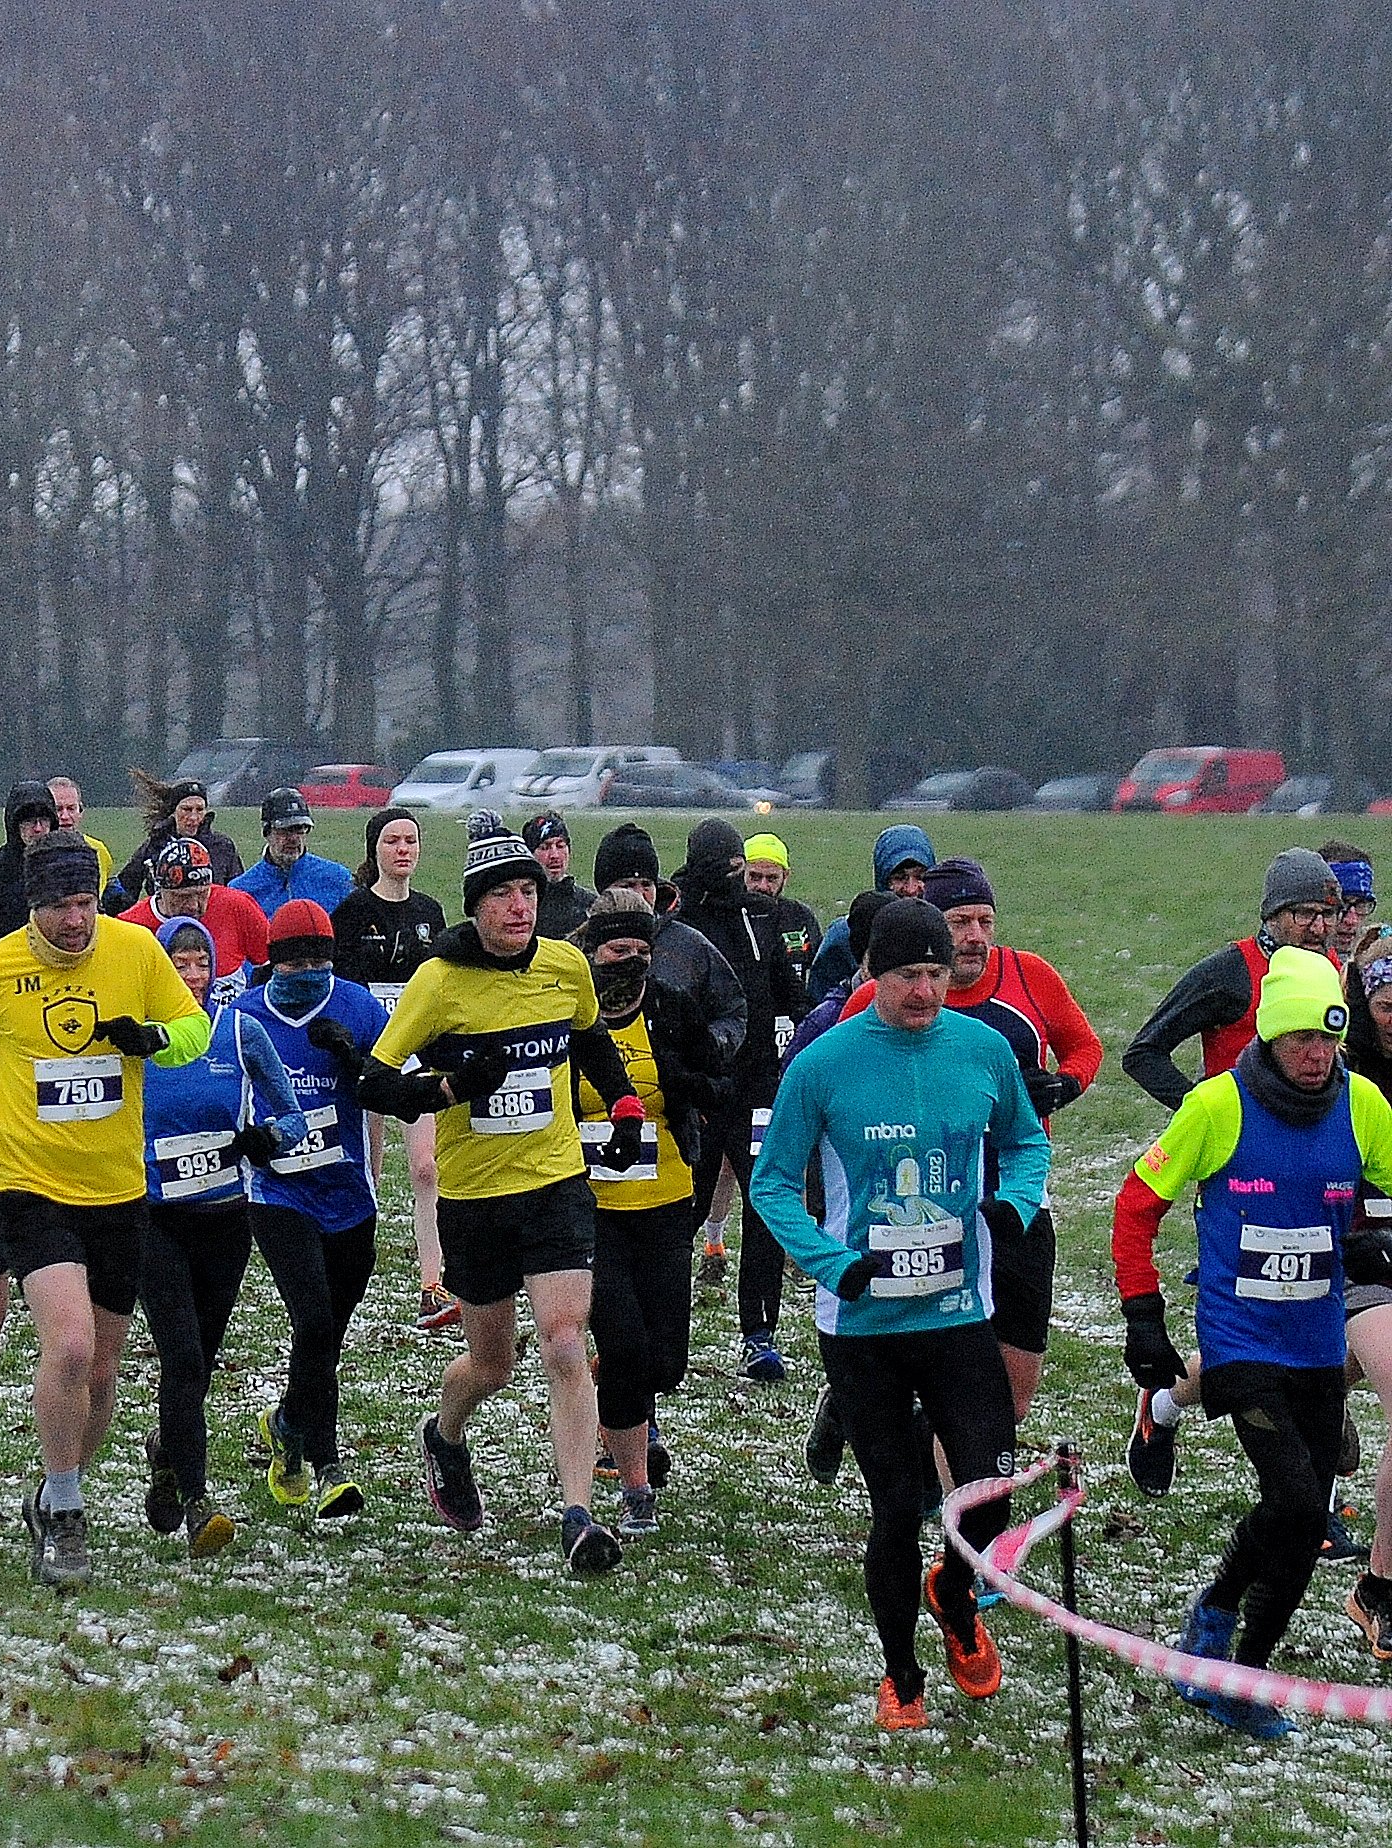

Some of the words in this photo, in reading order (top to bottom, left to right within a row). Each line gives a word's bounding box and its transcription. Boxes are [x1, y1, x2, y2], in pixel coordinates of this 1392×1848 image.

[14, 975, 41, 994] JM
[55, 1079, 104, 1104] 750
[488, 1091, 534, 1117] 886
[864, 1122, 916, 1139] mbna
[176, 1150, 221, 1179] 993
[929, 1156, 942, 1194] 2025
[1228, 1178, 1276, 1194] Martin
[892, 1247, 944, 1276] 895
[1261, 1254, 1311, 1280] 491
